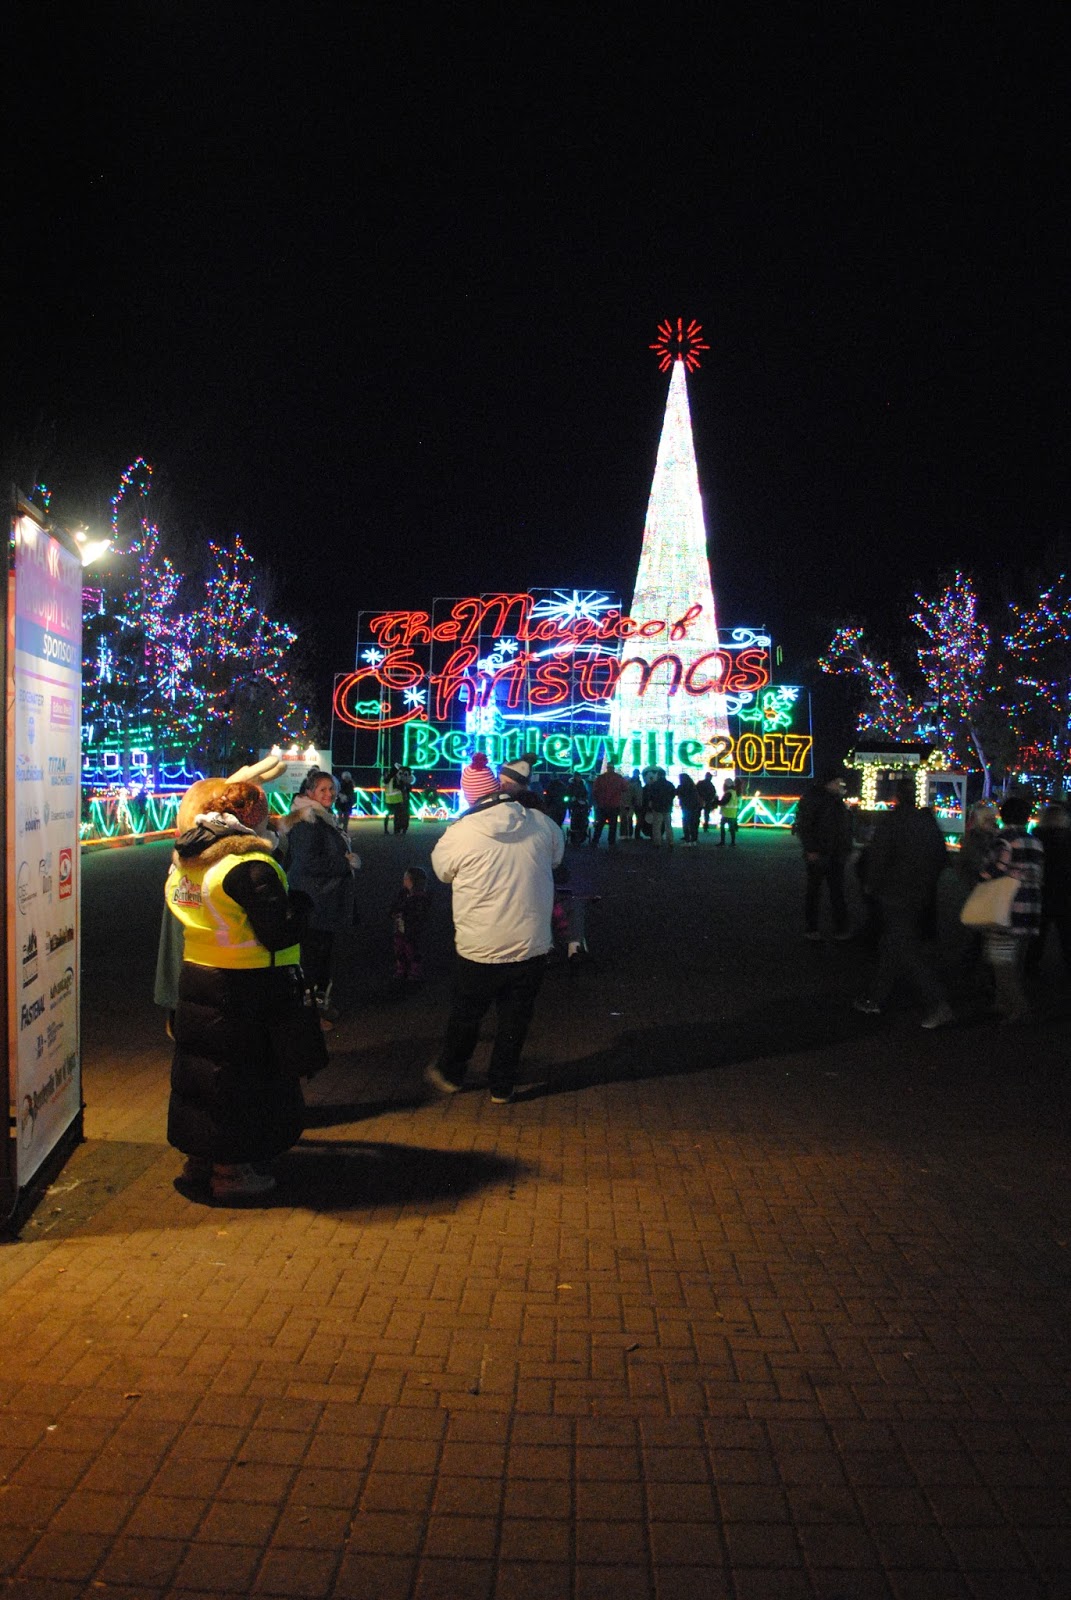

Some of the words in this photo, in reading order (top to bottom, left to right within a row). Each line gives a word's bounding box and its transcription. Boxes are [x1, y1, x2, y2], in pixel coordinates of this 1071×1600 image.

[43, 632, 77, 664] sponsors
[369, 611, 461, 649] The
[449, 593, 641, 658] Magic
[638, 604, 703, 643] of
[332, 644, 770, 730] Christmas
[48, 756, 68, 774] TITAN
[402, 720, 706, 773] Bentleyville
[706, 732, 813, 773] 2017
